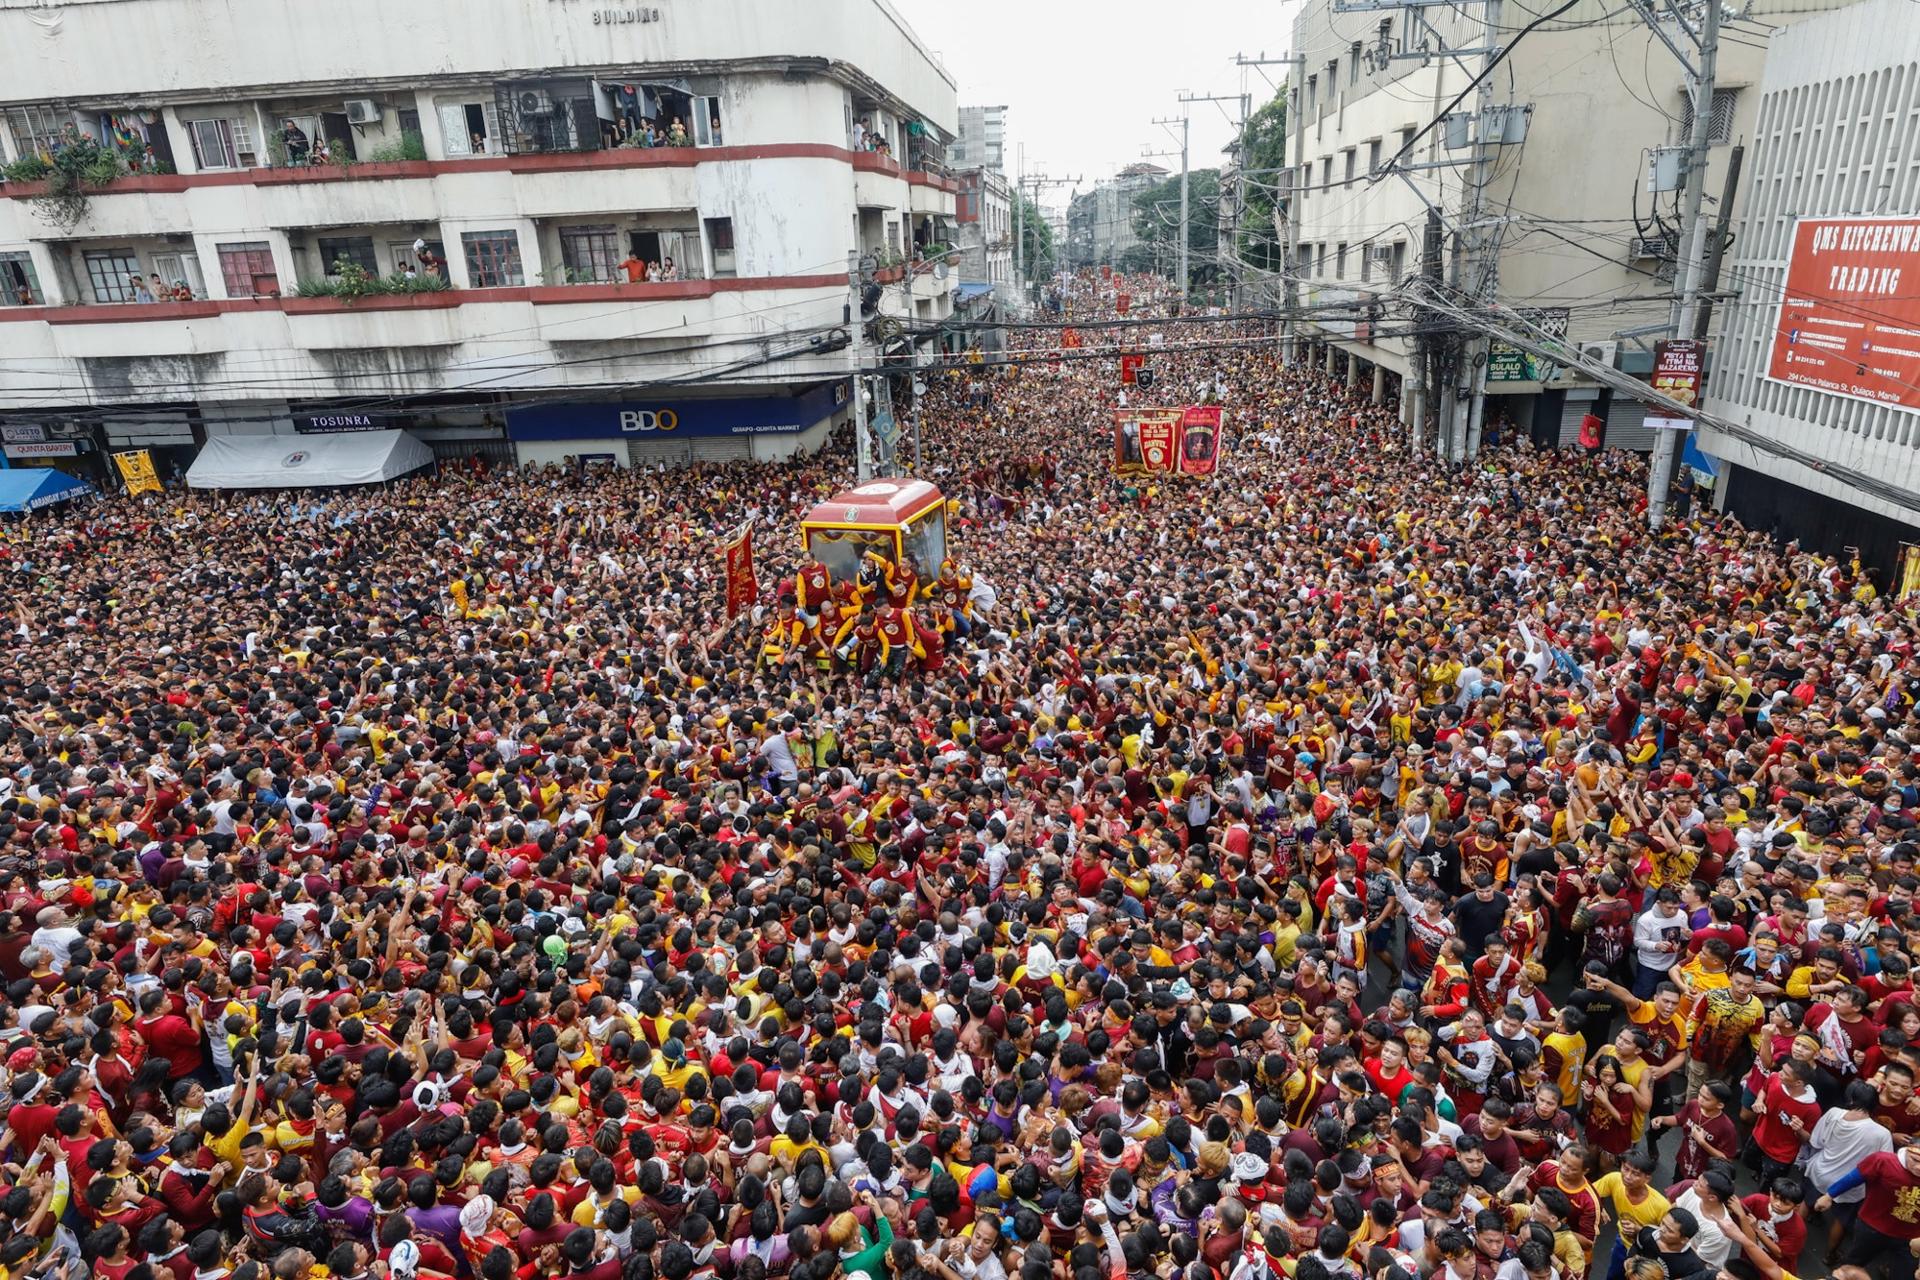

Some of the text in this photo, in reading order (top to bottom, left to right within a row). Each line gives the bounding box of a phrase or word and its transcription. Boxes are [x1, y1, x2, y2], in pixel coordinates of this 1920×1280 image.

[592, 8, 660, 25] BUILDING
[1812, 225, 1840, 256] QMS
[1829, 265, 1901, 294] TRADING
[1490, 363, 1521, 371] BULALO
[1877, 390, 1901, 402] Manila
[310, 415, 371, 427] TOSUNRA
[620, 408, 678, 432] BDO
